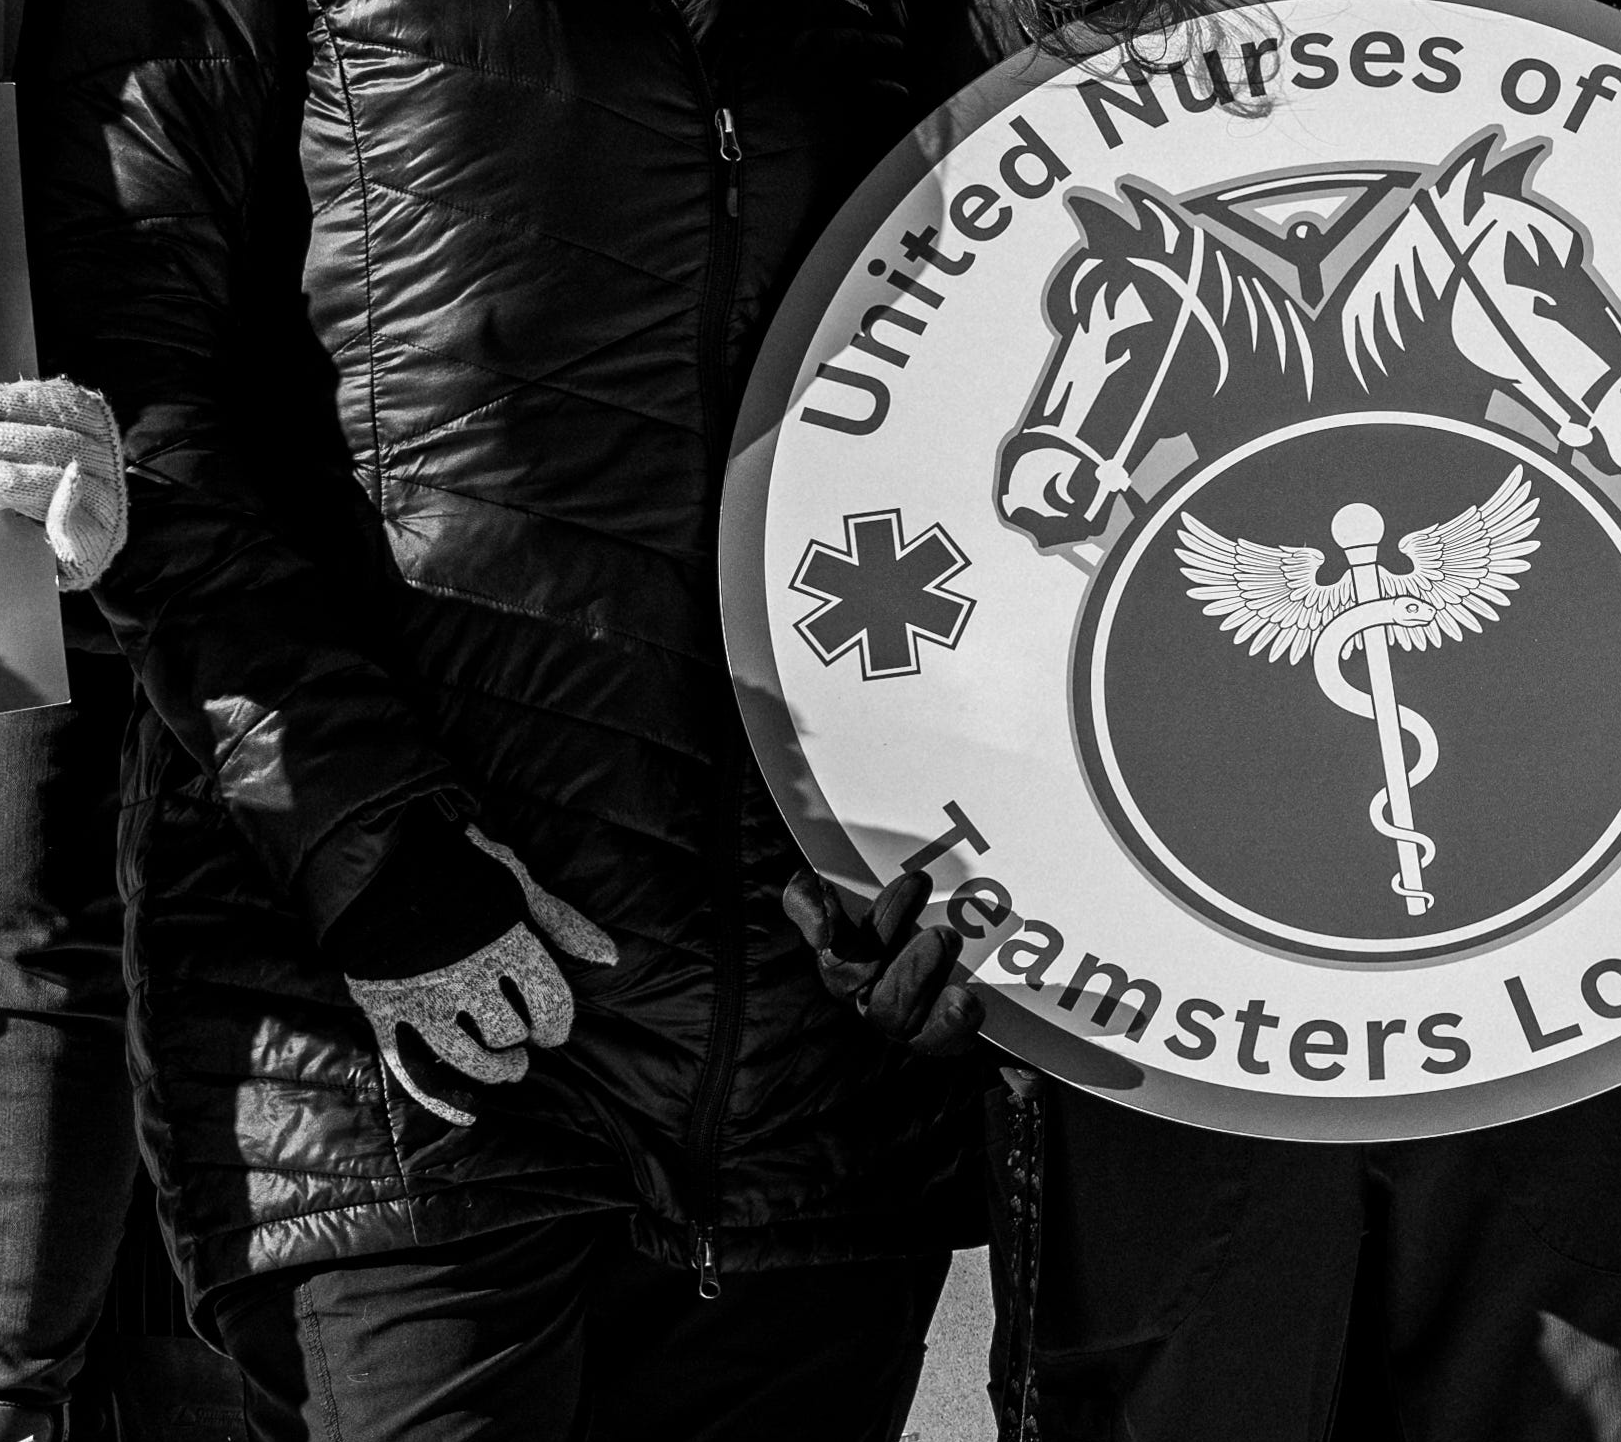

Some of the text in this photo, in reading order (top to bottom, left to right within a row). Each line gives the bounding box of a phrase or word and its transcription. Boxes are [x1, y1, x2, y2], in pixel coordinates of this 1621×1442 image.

[800, 108, 1071, 438] United
[1078, 29, 1466, 152] Nurses
[892, 798, 1471, 1082] Teamsters
